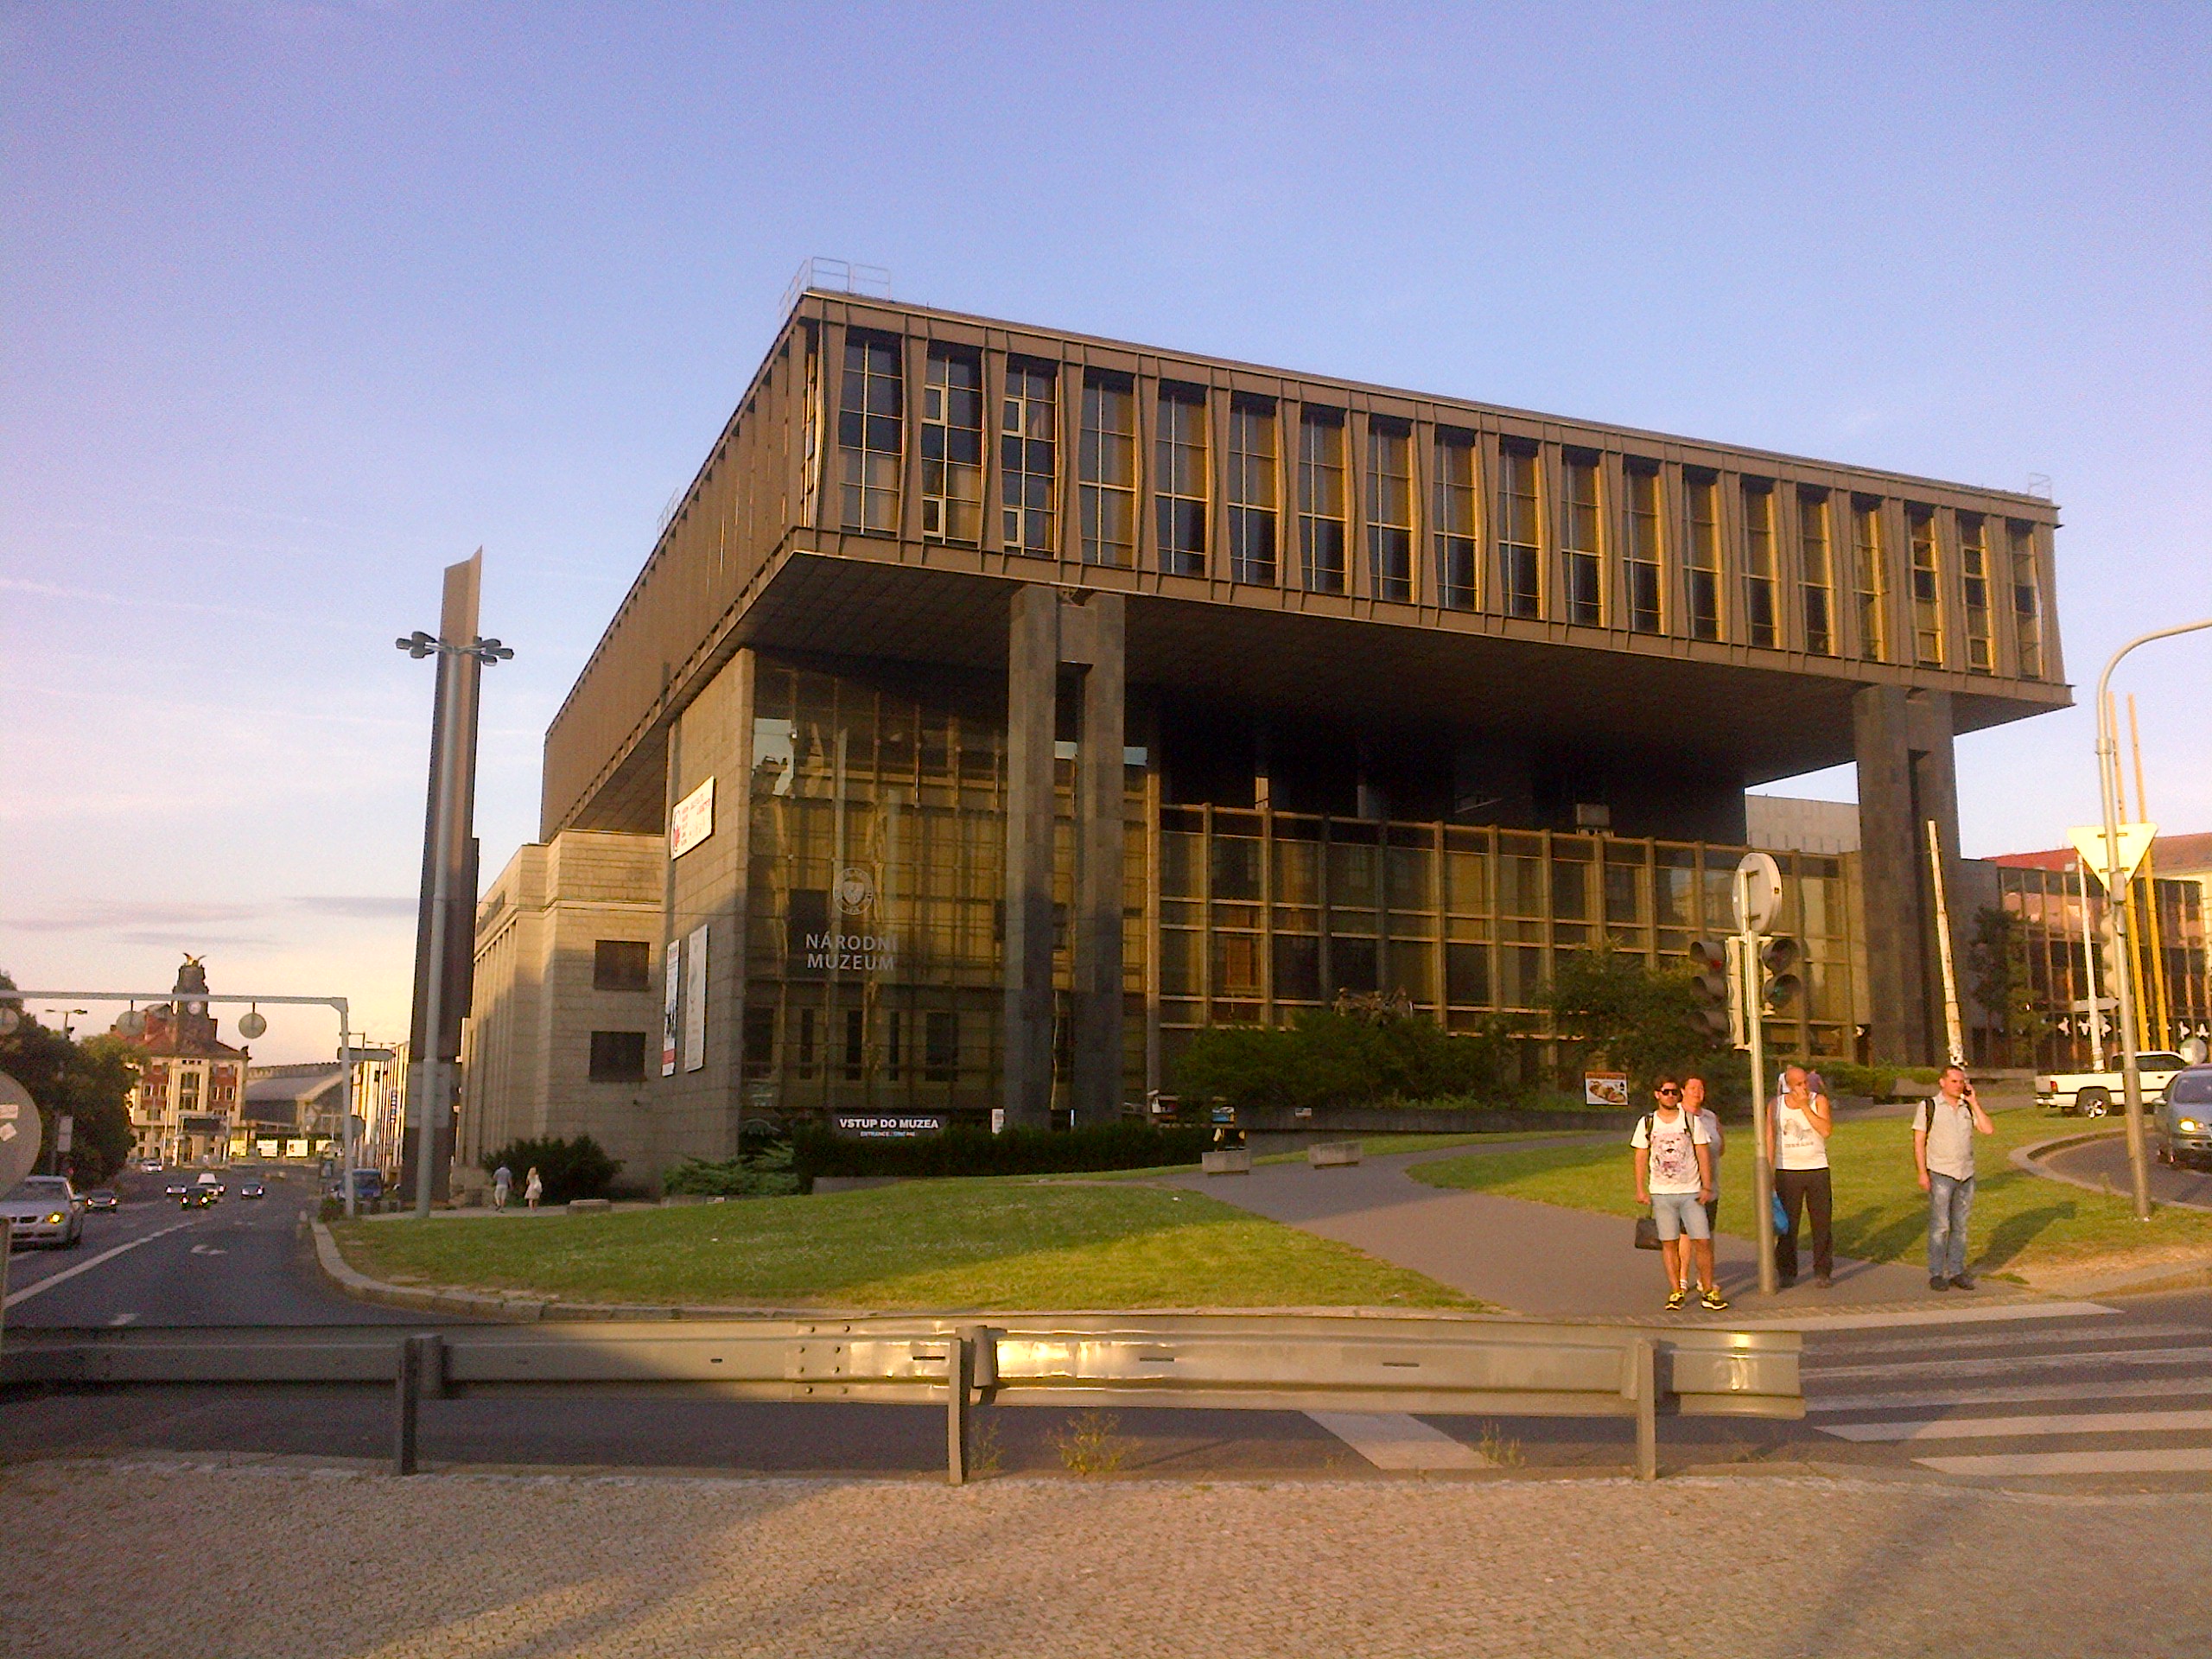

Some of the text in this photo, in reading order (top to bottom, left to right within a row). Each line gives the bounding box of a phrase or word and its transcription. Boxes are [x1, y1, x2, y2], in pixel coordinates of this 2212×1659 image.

[807, 953, 894, 970] MUZEUM
[839, 1118, 939, 1128] VSTUP DO MUZEA
